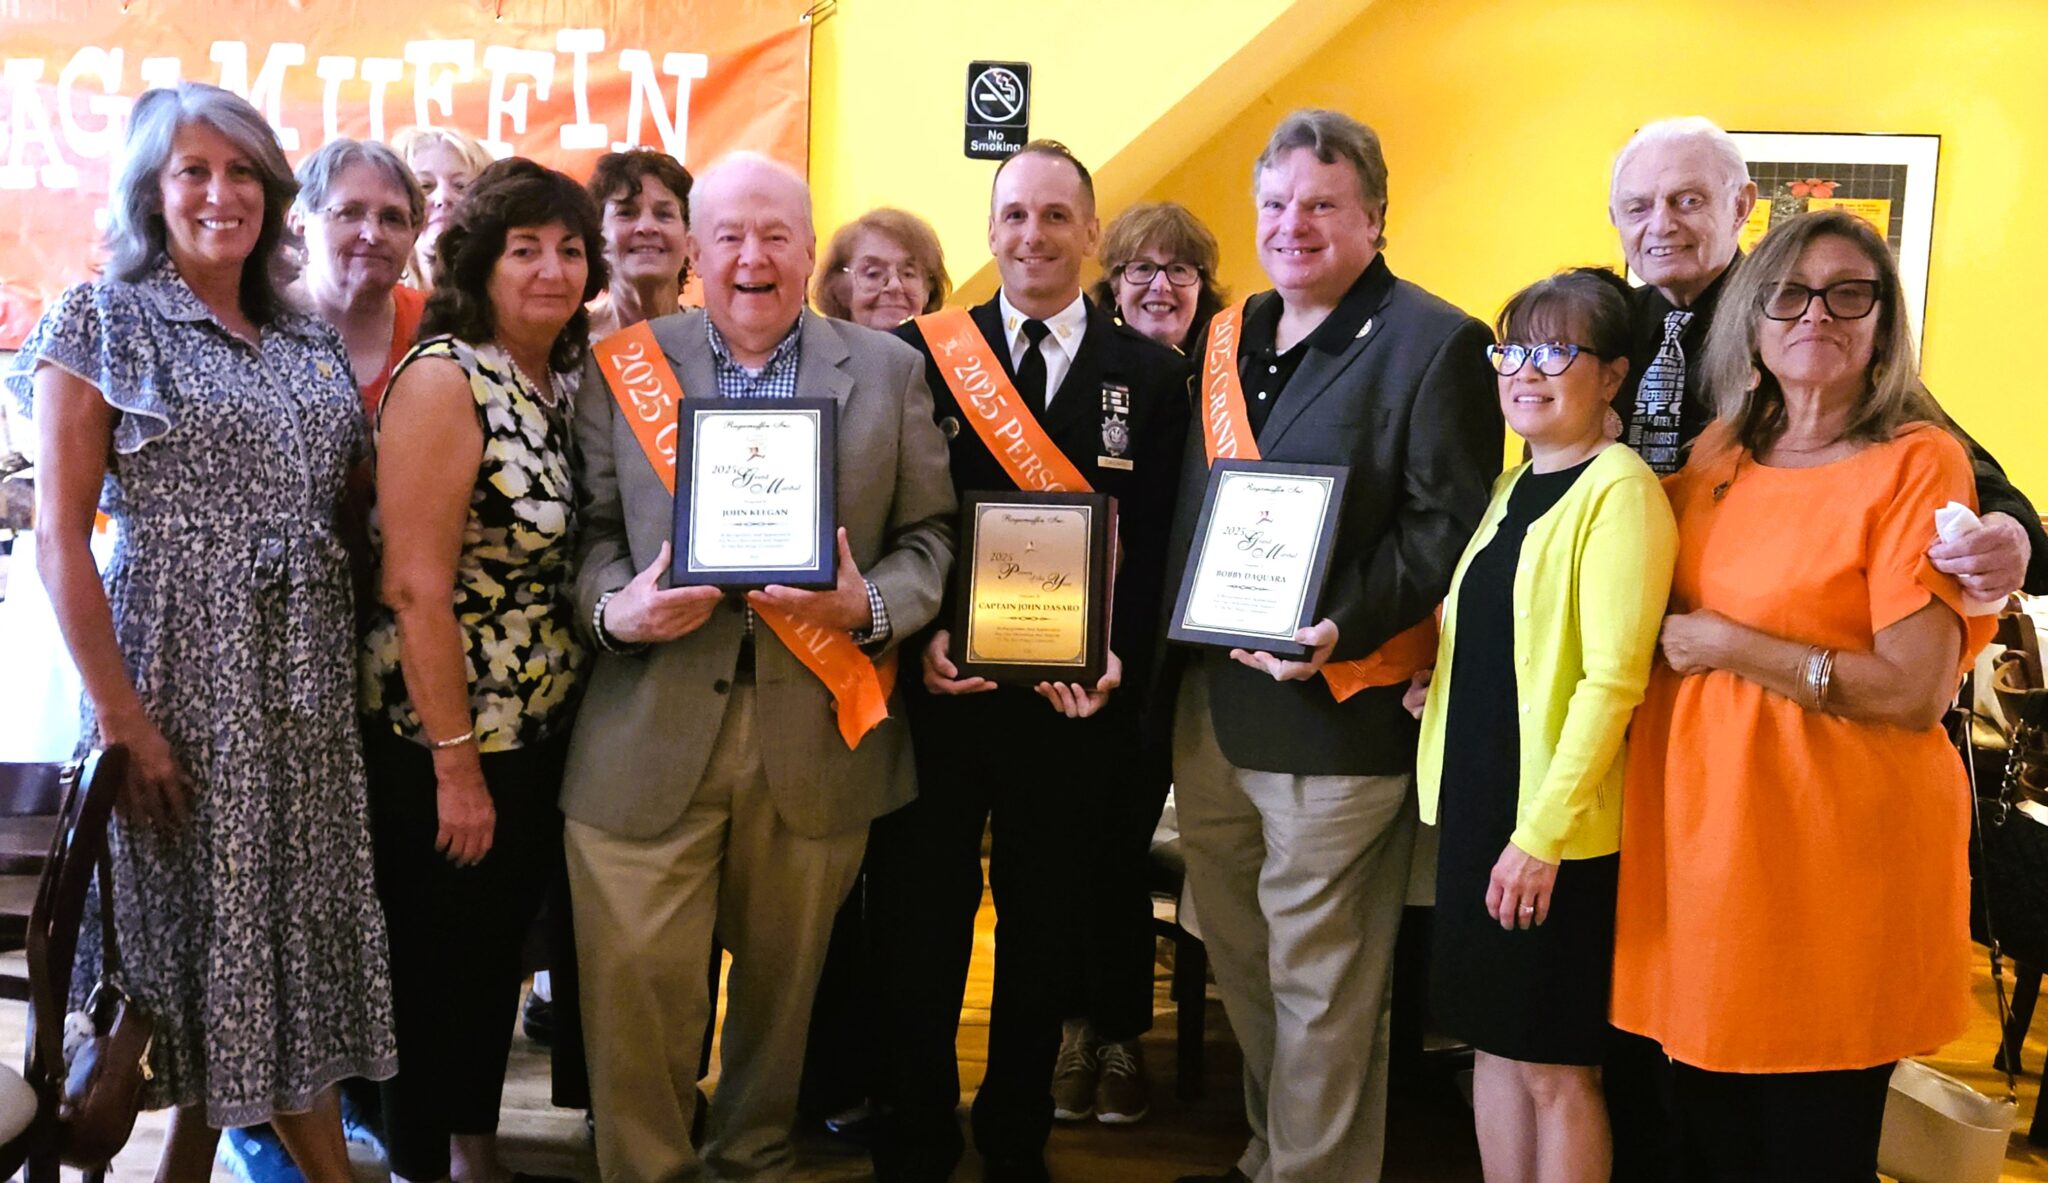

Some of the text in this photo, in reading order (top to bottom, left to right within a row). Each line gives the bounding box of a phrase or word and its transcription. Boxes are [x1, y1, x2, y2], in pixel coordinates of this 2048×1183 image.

[988, 129, 1005, 141] No
[970, 139, 1021, 152] Smoking
[1209, 311, 1235, 375] 2025
[611, 341, 672, 422] 2025
[953, 355, 1008, 420] 2025
[711, 464, 770, 488] 2025 Grand
[722, 509, 748, 517] JOHN
[1222, 526, 1246, 537] 2025
[989, 552, 1014, 562] 2025
[1216, 570, 1242, 579] BOBBY
[978, 602, 1080, 613] CAPTAIN JOHN DASARO
